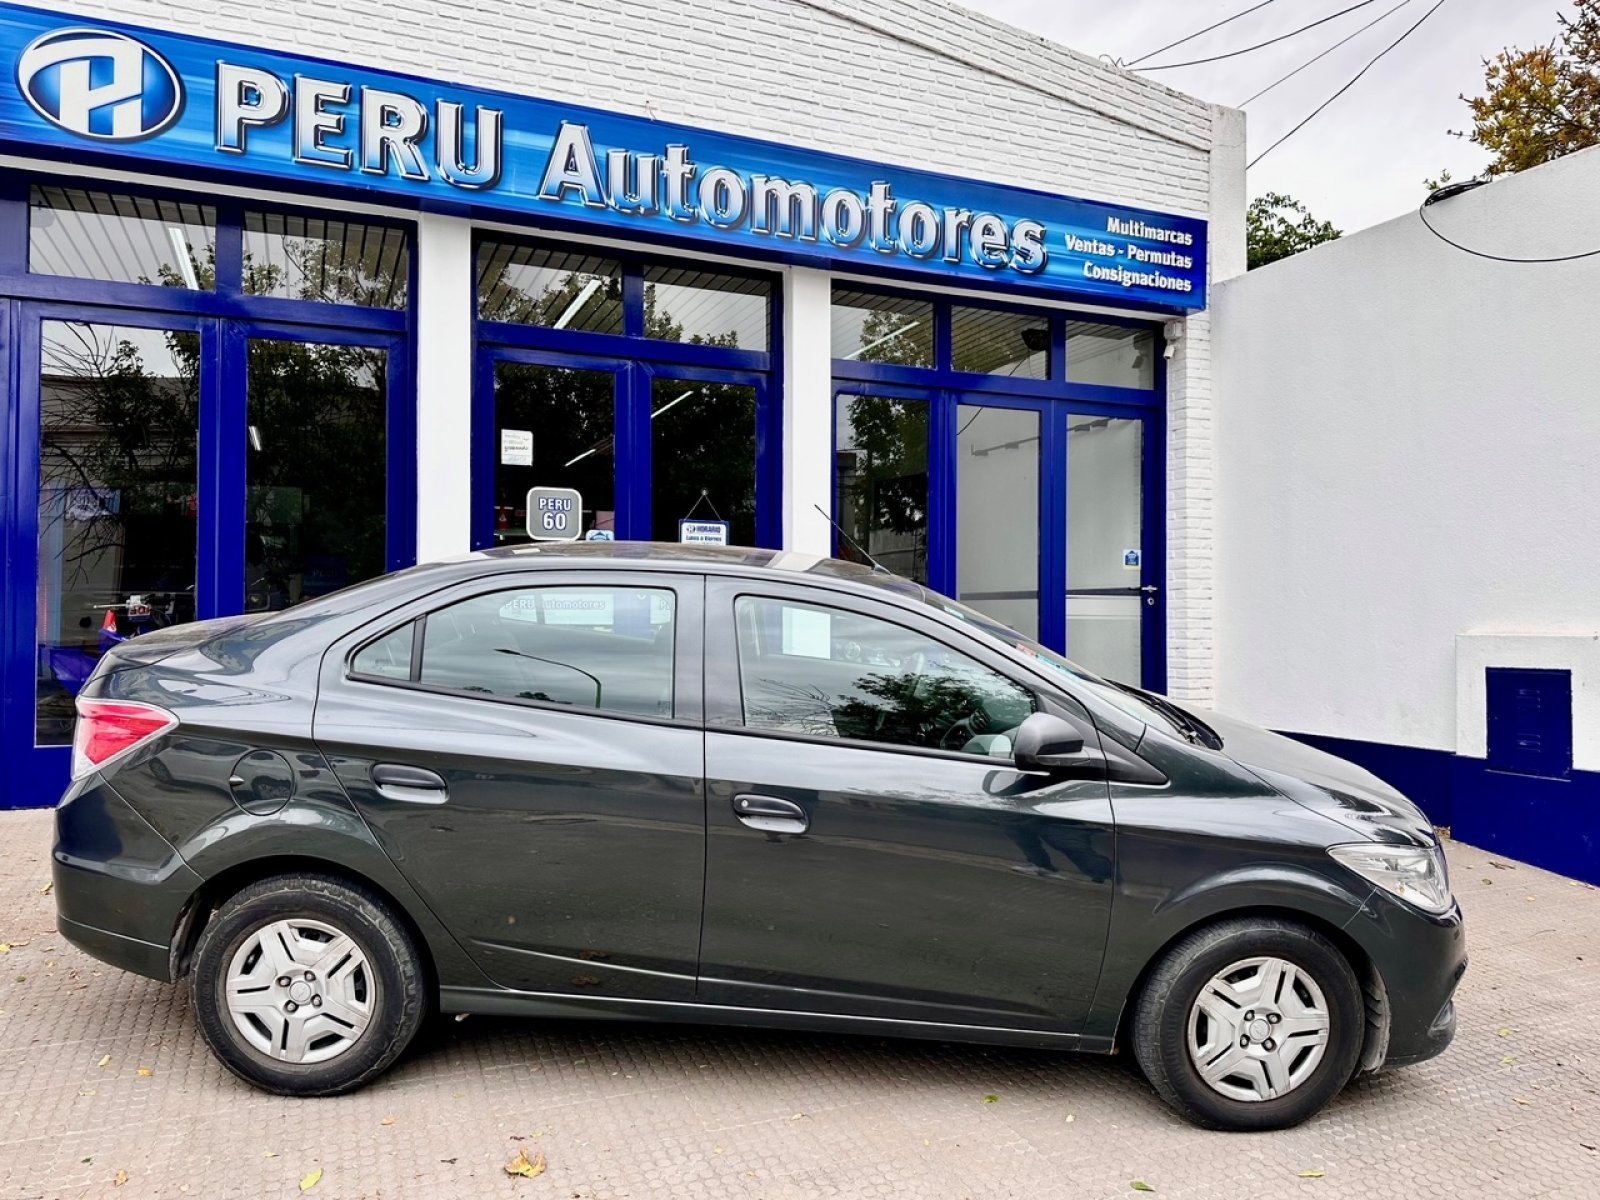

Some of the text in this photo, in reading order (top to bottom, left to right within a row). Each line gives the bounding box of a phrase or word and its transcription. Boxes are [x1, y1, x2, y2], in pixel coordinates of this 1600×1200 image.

[214, 59, 1048, 274] PERU Automotores
[1106, 216, 1193, 246] Multimarcas
[1064, 232, 1116, 256] Ventas
[1127, 244, 1193, 269] Permutas
[1083, 260, 1192, 292] Consignaciones
[539, 498, 571, 511] PERU
[543, 511, 566, 530] 60
